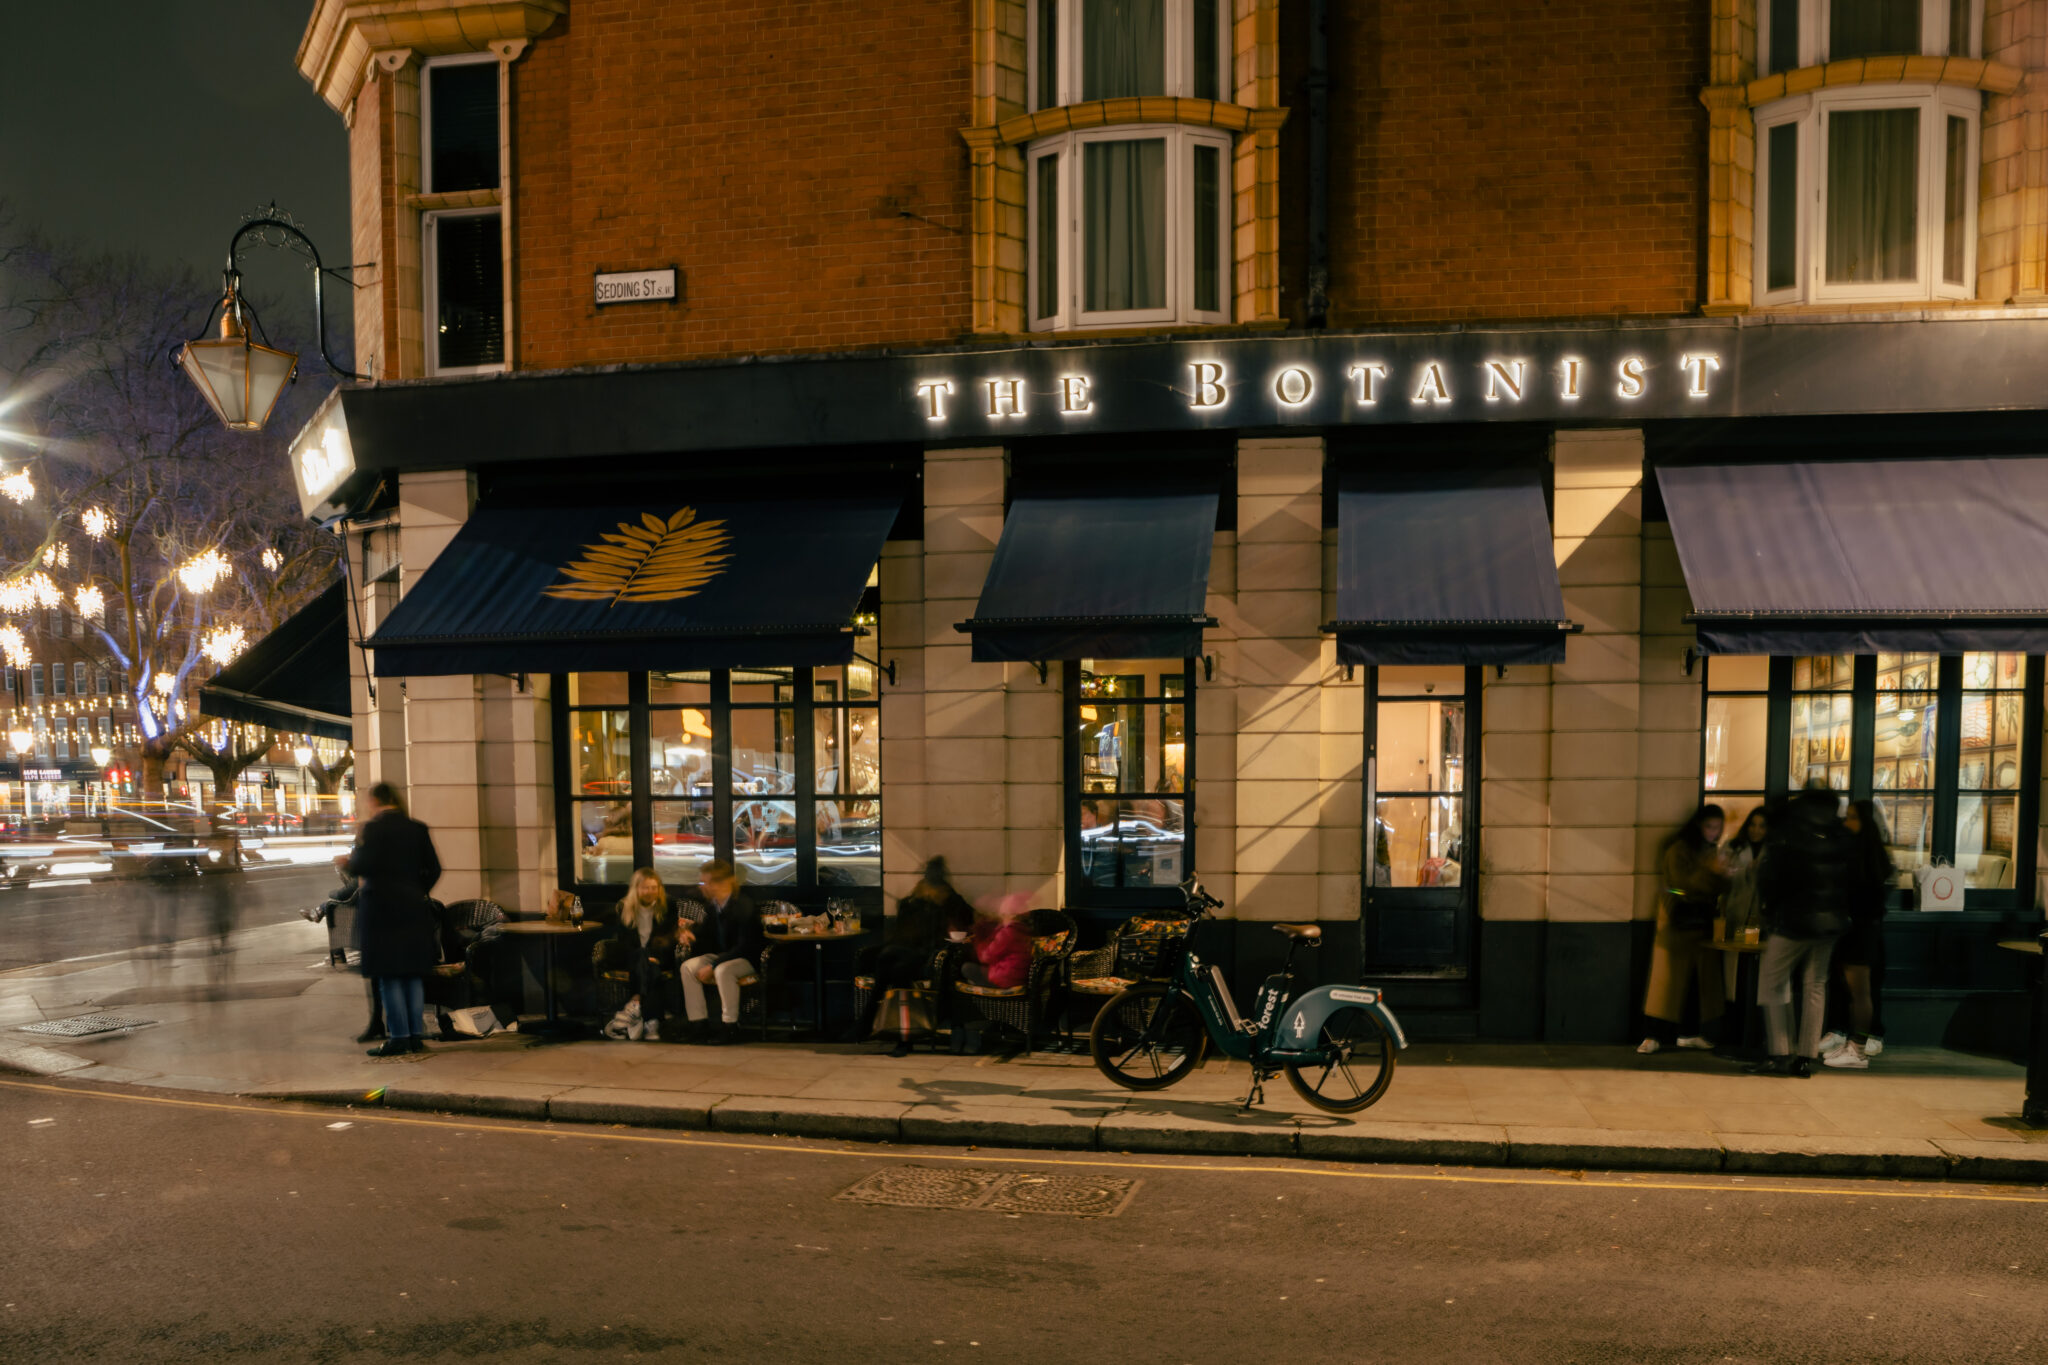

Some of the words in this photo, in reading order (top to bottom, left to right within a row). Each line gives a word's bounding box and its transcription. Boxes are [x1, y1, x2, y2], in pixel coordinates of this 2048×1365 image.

[596, 281, 640, 300] SEDDING
[917, 377, 1093, 421] THE
[1188, 352, 1721, 411] BOTANIST
[1256, 988, 1279, 1030] forest
